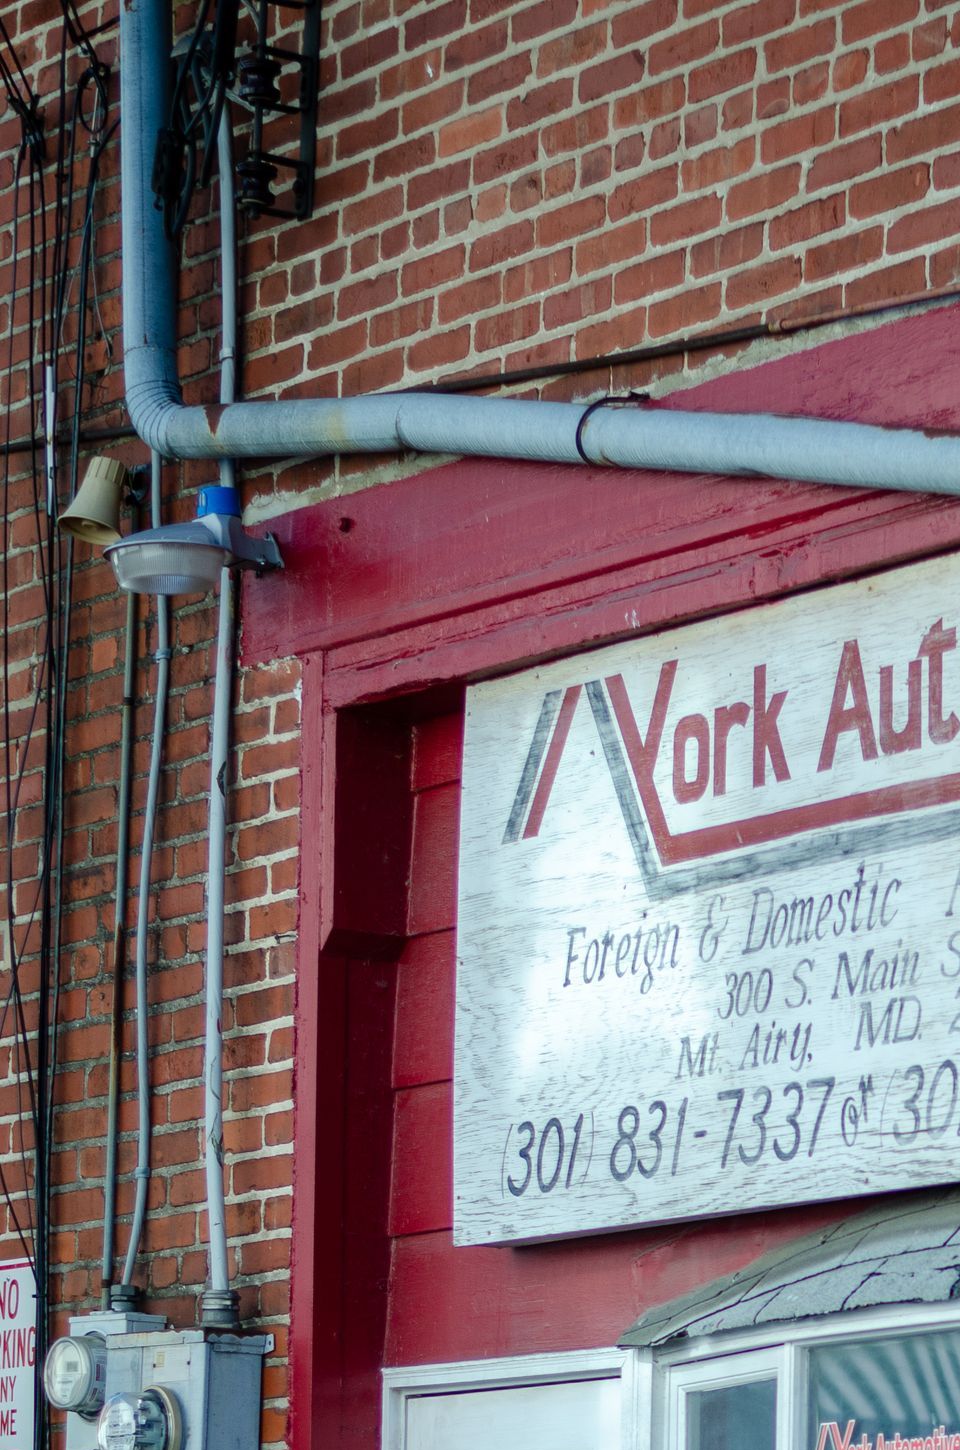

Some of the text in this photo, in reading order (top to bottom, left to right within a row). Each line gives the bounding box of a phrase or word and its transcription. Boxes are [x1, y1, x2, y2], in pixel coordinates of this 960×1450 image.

[605, 659, 791, 812] York
[563, 921, 680, 994] Foreign
[699, 894, 728, 963] &
[742, 861, 902, 955] Domestic
[718, 968, 773, 1020] 300
[784, 958, 815, 1009] S.
[831, 938, 920, 1000] Main
[675, 1031, 722, 1080] Mt.
[738, 1021, 814, 1072] Airy,
[853, 995, 922, 1051] MD.
[501, 1111, 595, 1198] (301)
[610, 1076, 836, 1182] 831-7337
[0, 1326, 36, 1369] KING
[0, 1375, 17, 1402] NY
[0, 1409, 17, 1436] ME
